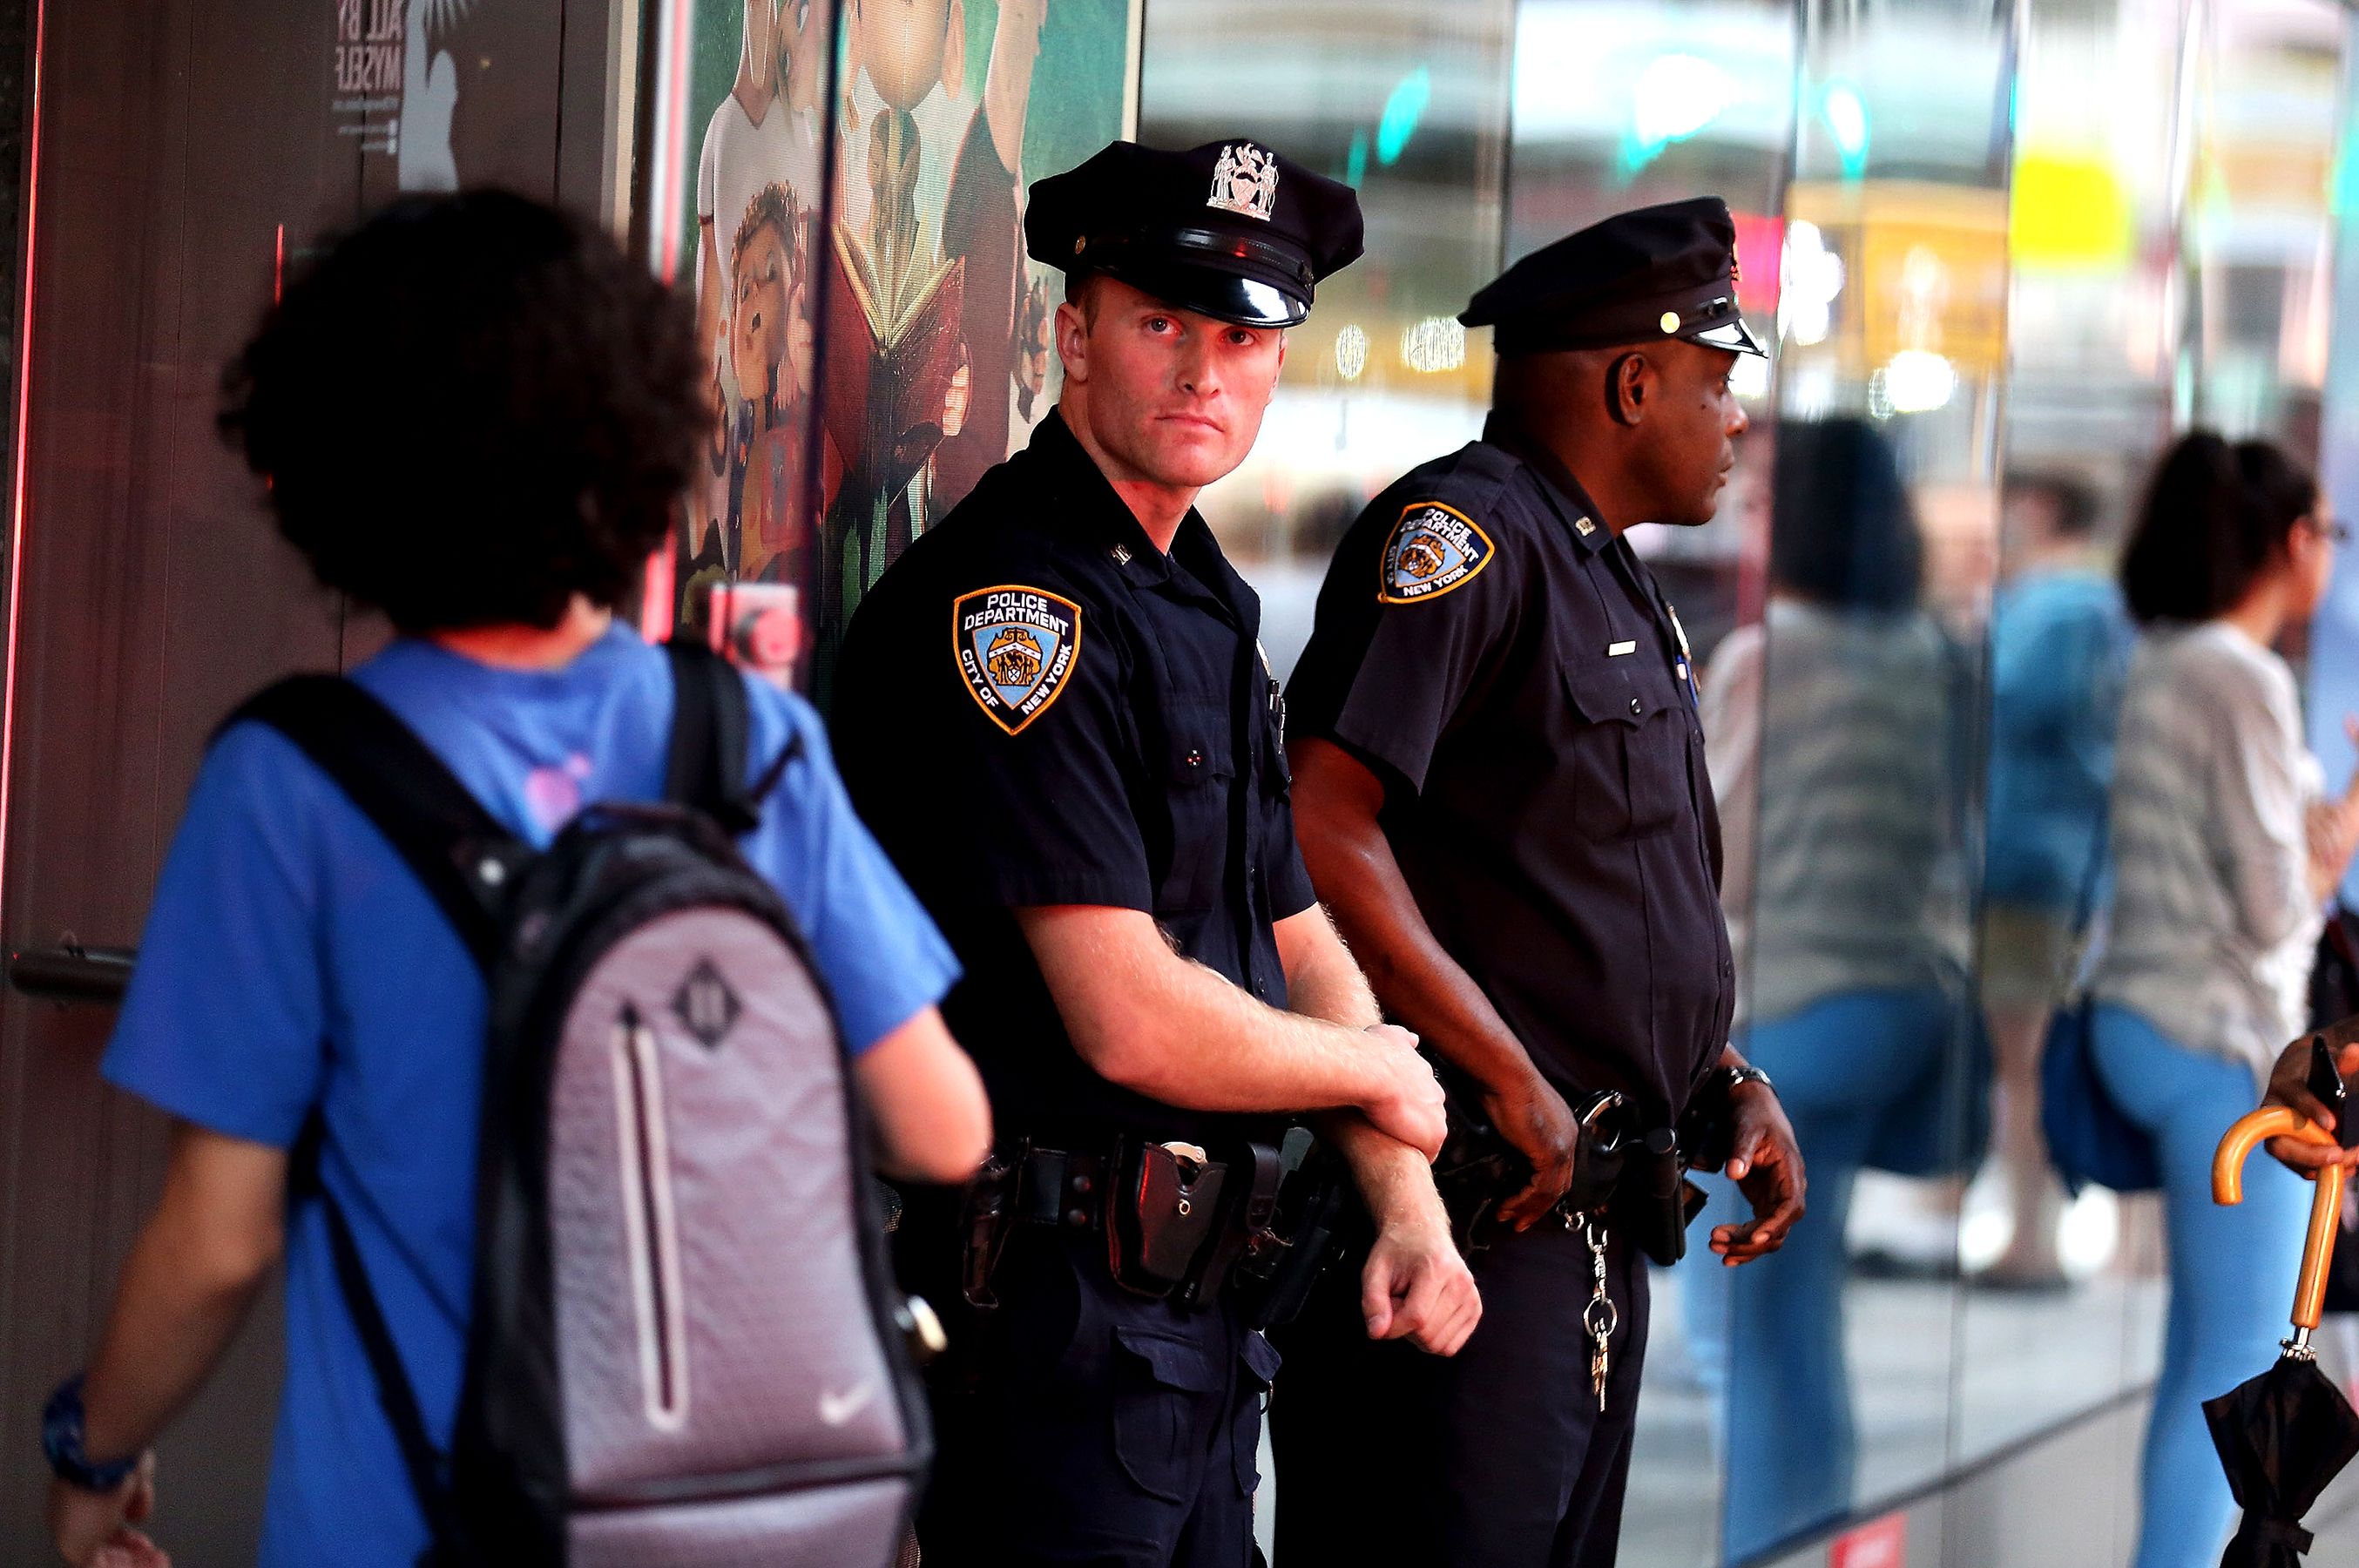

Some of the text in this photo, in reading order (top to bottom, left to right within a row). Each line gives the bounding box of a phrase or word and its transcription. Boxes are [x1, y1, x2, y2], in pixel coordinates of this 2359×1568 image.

[1423, 508, 1473, 540] POLICE
[1403, 564, 1469, 597] NEW YORK
[987, 592, 1048, 612] POLICE
[963, 606, 1069, 636] DEPARTMENT
[962, 649, 999, 707] CITY OF
[1020, 644, 1073, 715] NEW YORK
